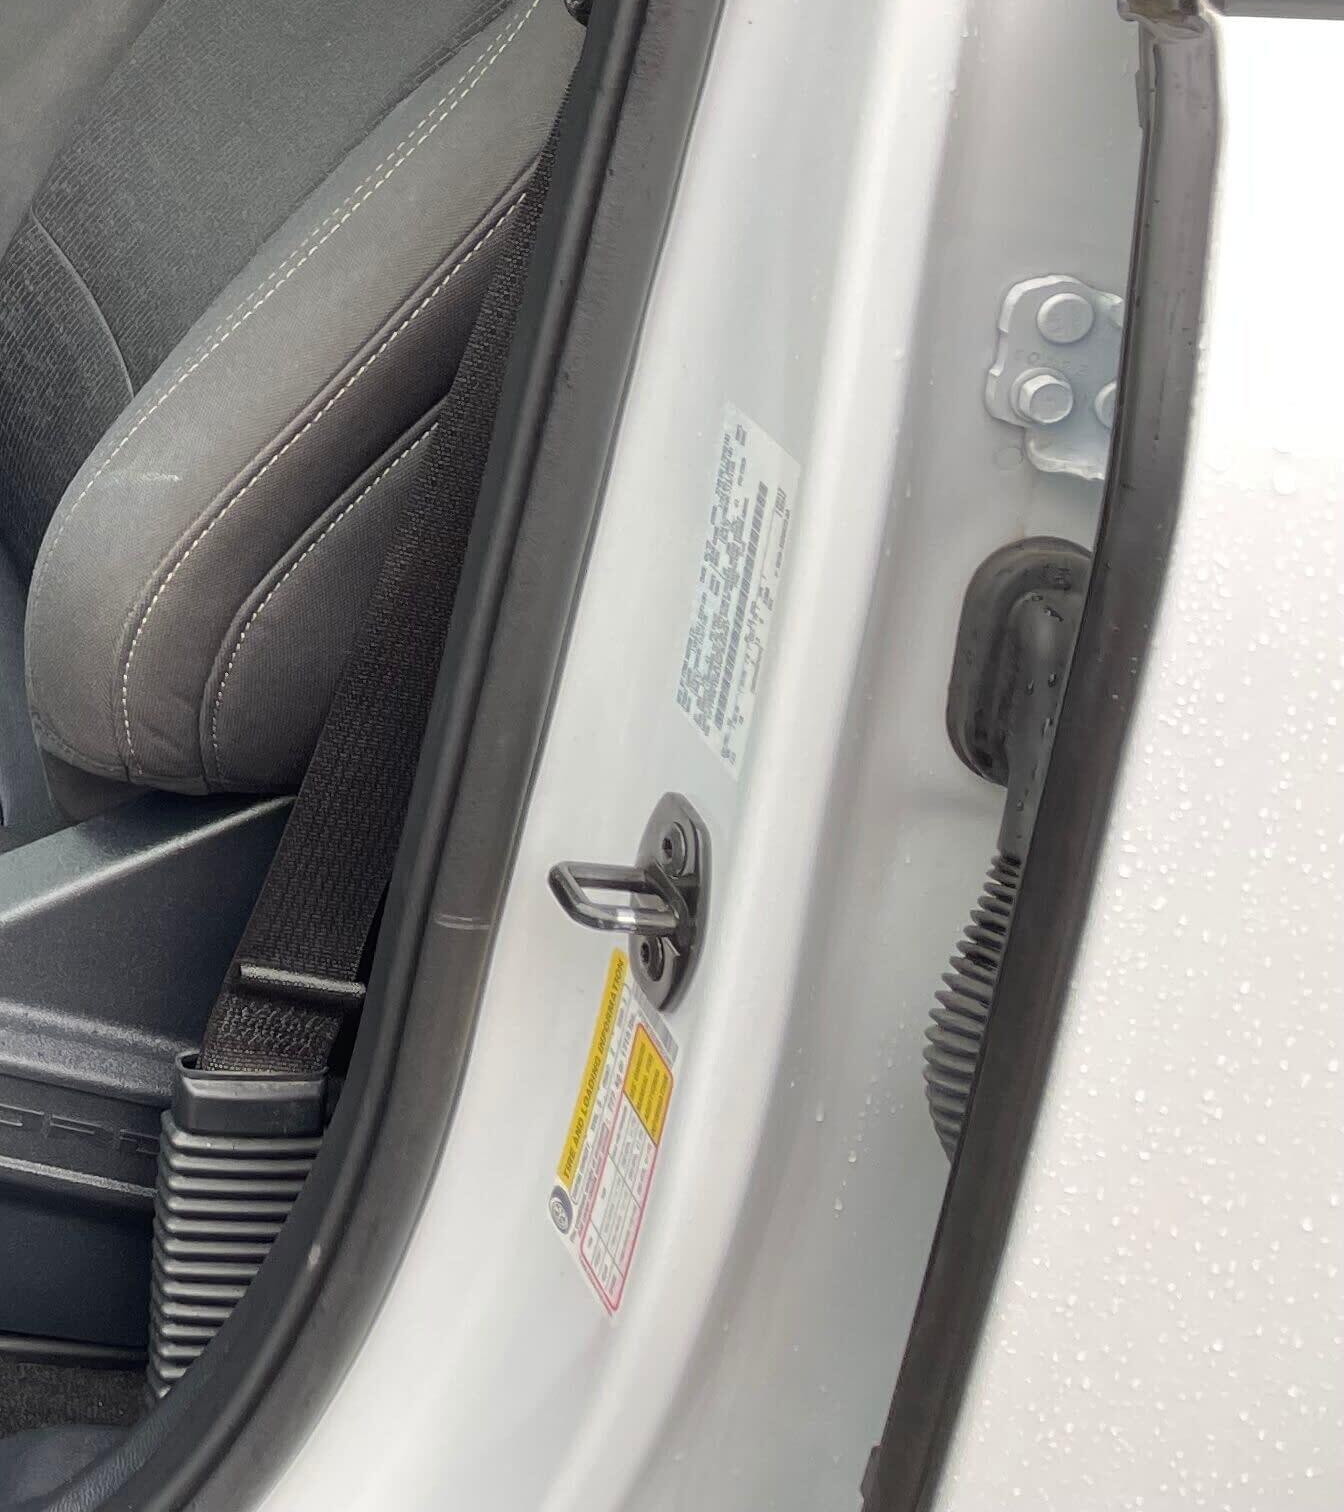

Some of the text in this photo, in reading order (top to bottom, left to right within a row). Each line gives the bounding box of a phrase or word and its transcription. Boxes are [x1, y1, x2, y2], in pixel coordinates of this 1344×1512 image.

[573, 1116, 585, 1146] AND
[582, 1055, 602, 1115] LOADING
[598, 959, 625, 1054] INFORMATION
